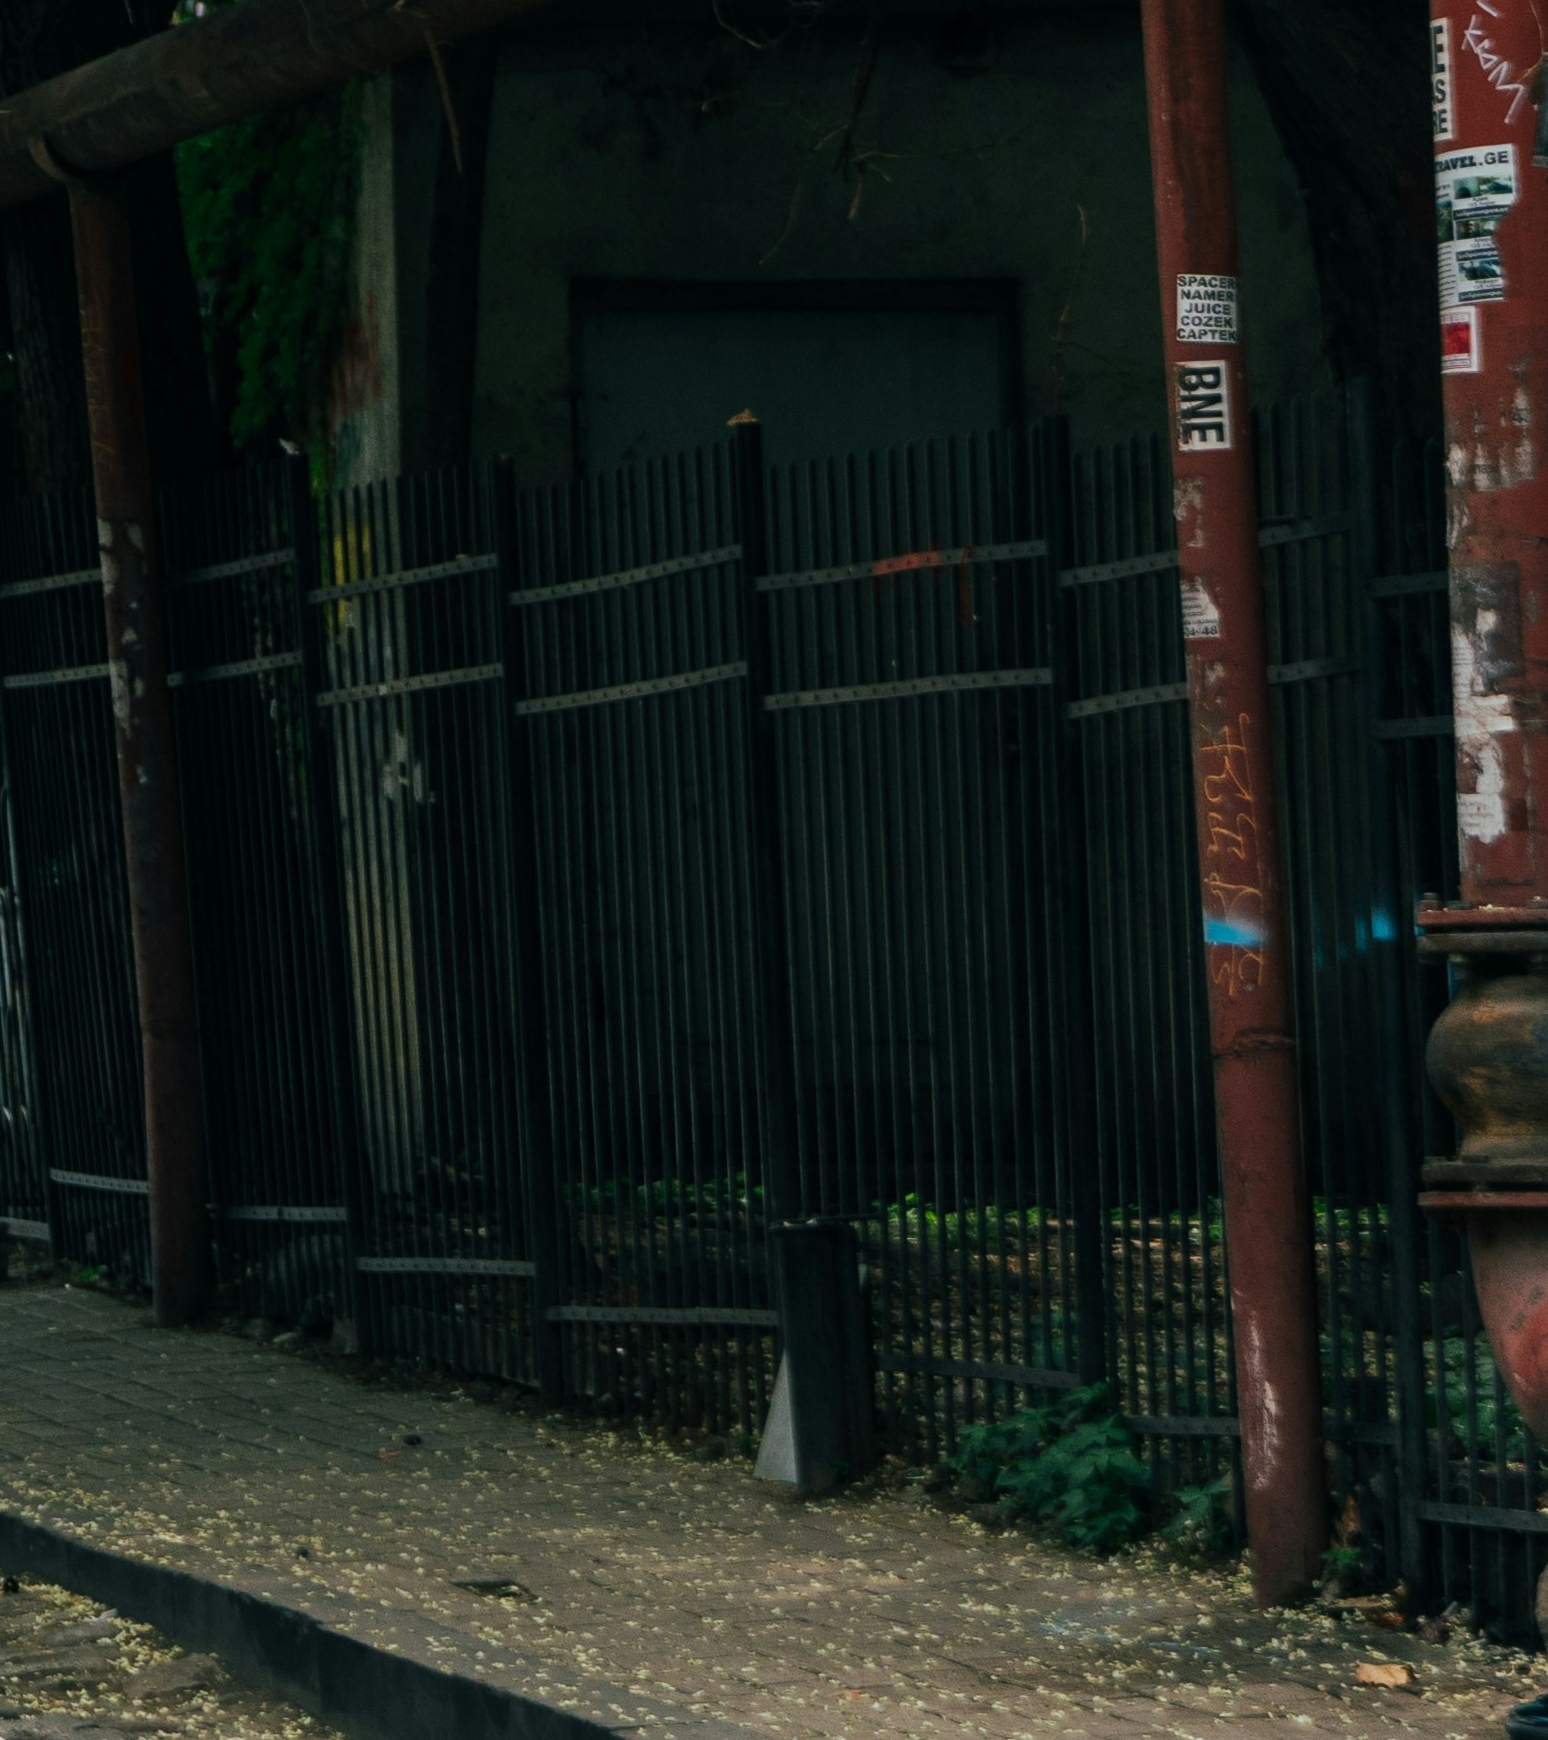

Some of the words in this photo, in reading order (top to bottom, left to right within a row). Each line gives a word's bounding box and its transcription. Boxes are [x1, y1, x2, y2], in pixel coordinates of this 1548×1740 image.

[1177, 275, 1237, 290] SPACER
[1180, 289, 1235, 302] NAMER
[1185, 302, 1231, 316] JUICE
[1181, 315, 1234, 329] COZEK
[1177, 327, 1238, 342] CAPTEK
[1177, 365, 1226, 445] BNE
